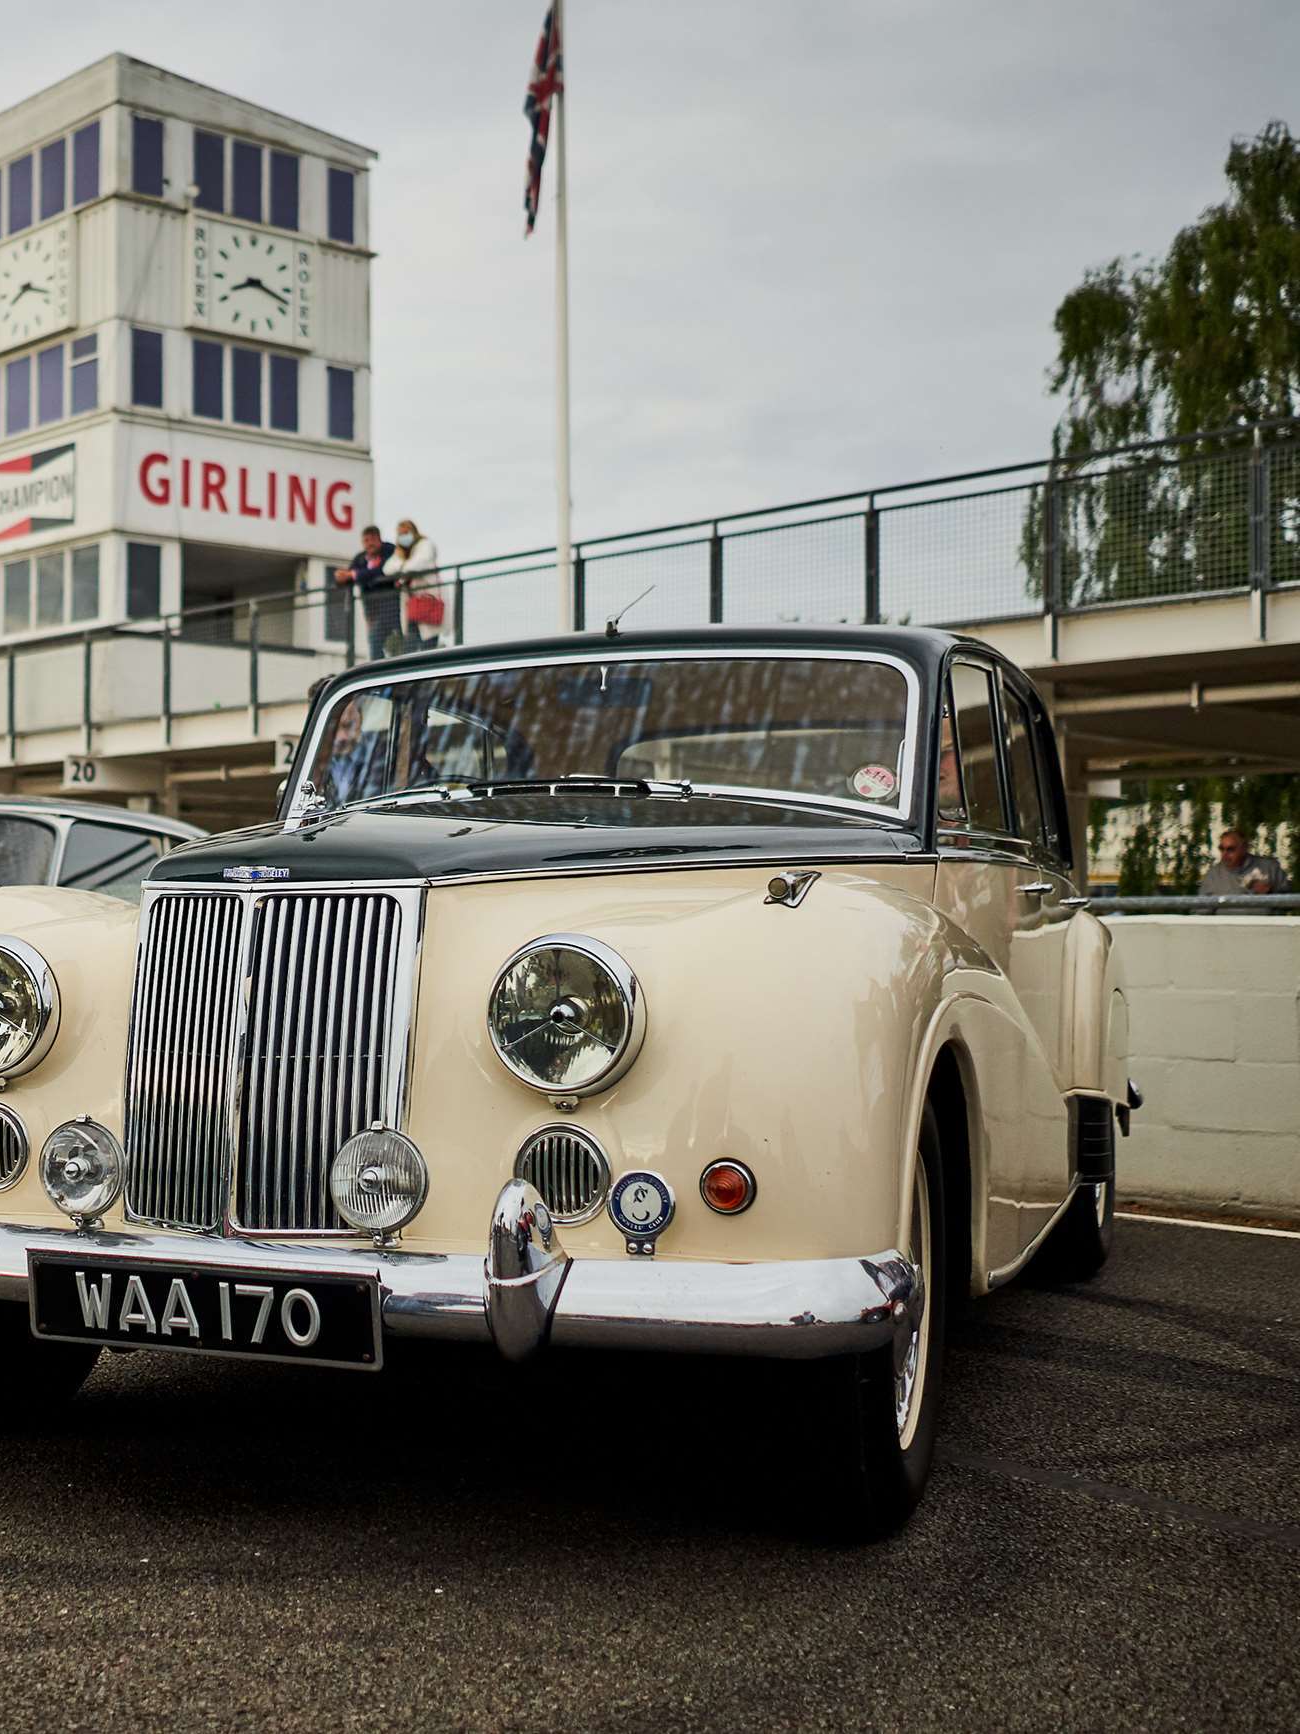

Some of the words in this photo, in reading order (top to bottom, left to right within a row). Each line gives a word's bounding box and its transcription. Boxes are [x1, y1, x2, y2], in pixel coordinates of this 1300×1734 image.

[139, 452, 354, 531] GIRLING
[72, 760, 96, 782] 20
[75, 1271, 200, 1338] WAA
[218, 1281, 321, 1347] 170
